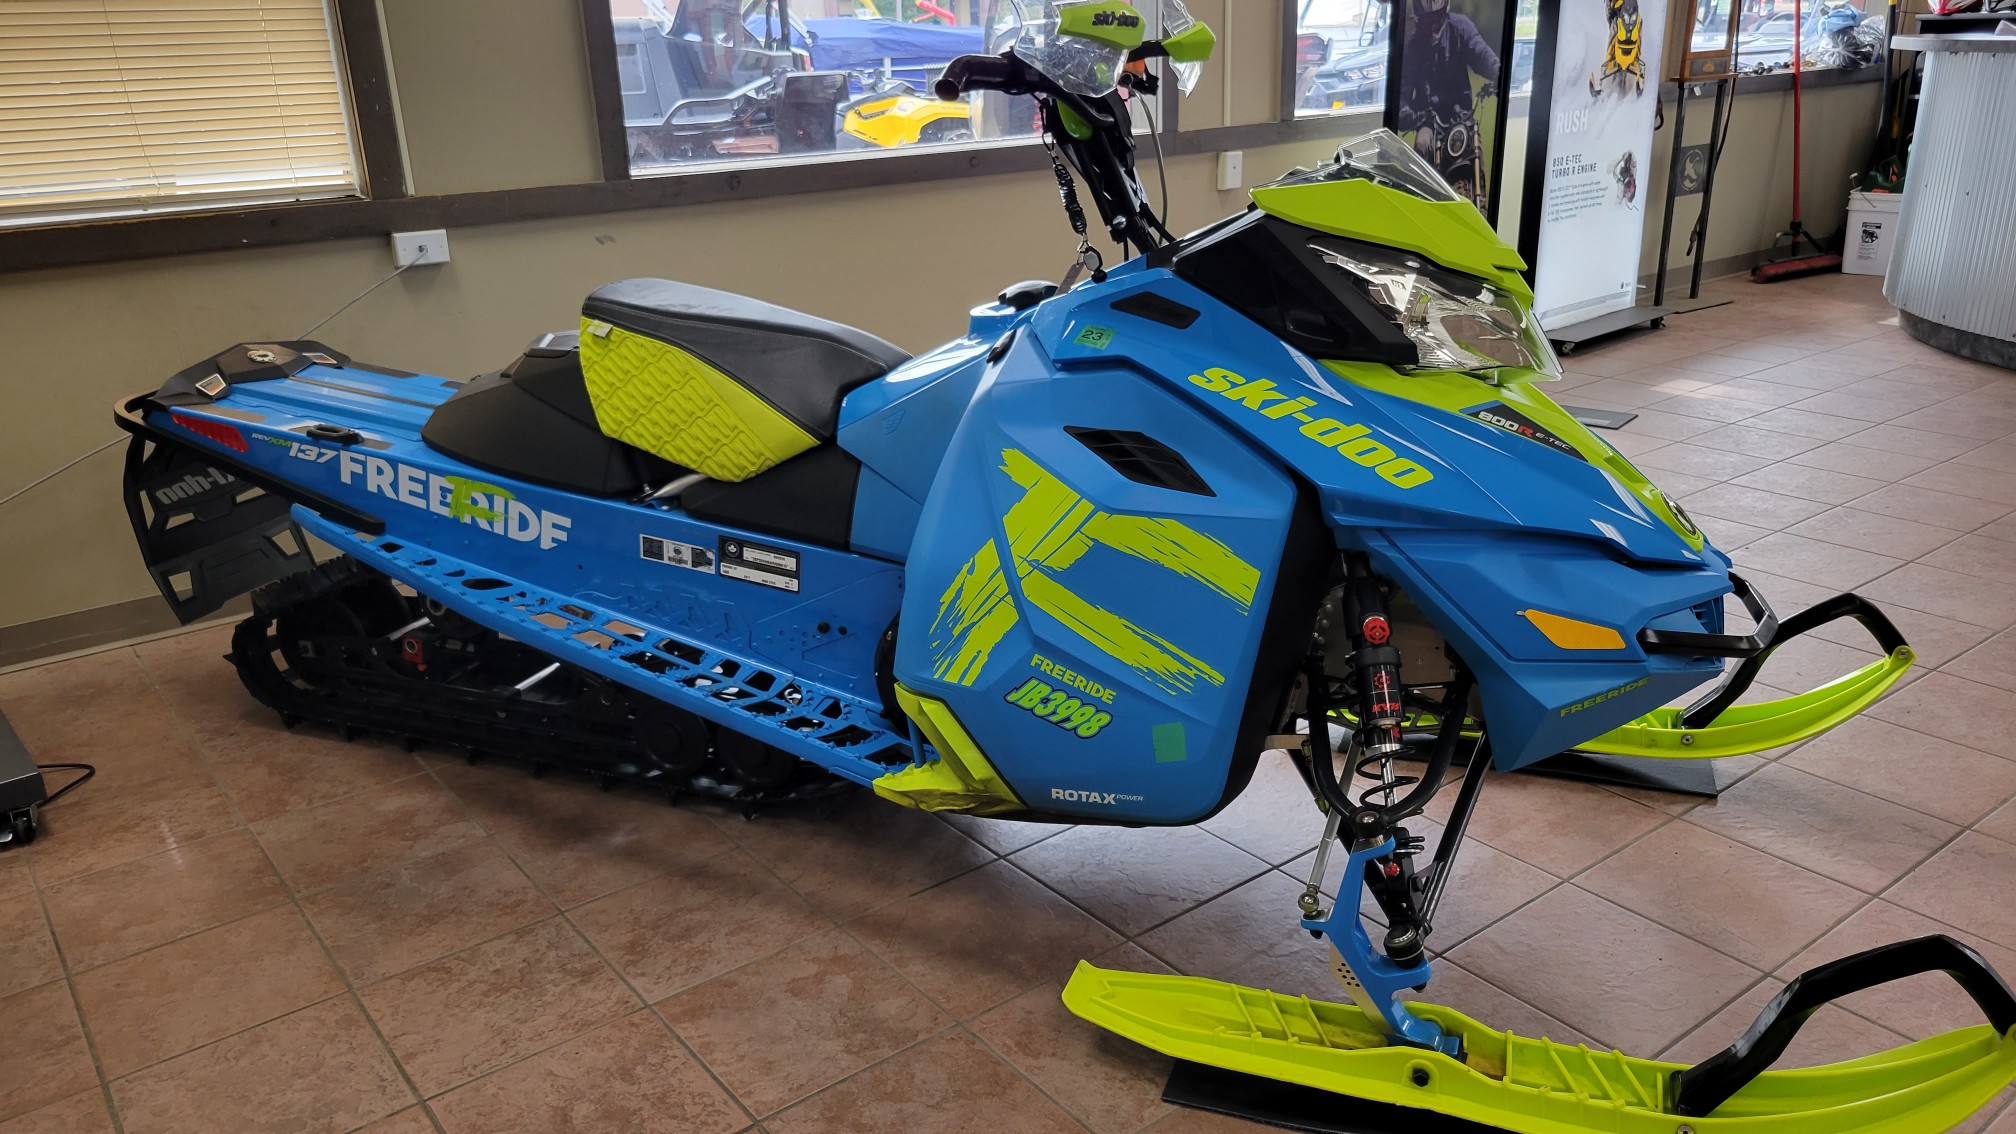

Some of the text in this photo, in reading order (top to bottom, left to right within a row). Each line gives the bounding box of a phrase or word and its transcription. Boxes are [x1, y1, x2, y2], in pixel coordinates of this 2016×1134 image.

[1556, 109, 1589, 136] RUSH
[1551, 167, 1570, 179] TURBO
[1577, 162, 1597, 175] ENGINE
[1553, 153, 1582, 168] 850 E-TEC
[1081, 330, 1104, 341] 23
[1187, 367, 1434, 489] ski-doo
[1477, 411, 1572, 451] 800R E-TEC
[288, 441, 339, 464] 137
[339, 449, 573, 550] FREERIDE
[1030, 653, 1117, 705] FREERIDE
[1003, 675, 1113, 739] JB3998
[1560, 677, 1649, 718] FREERIDE
[1051, 788, 1144, 805] ROTAX POWER
